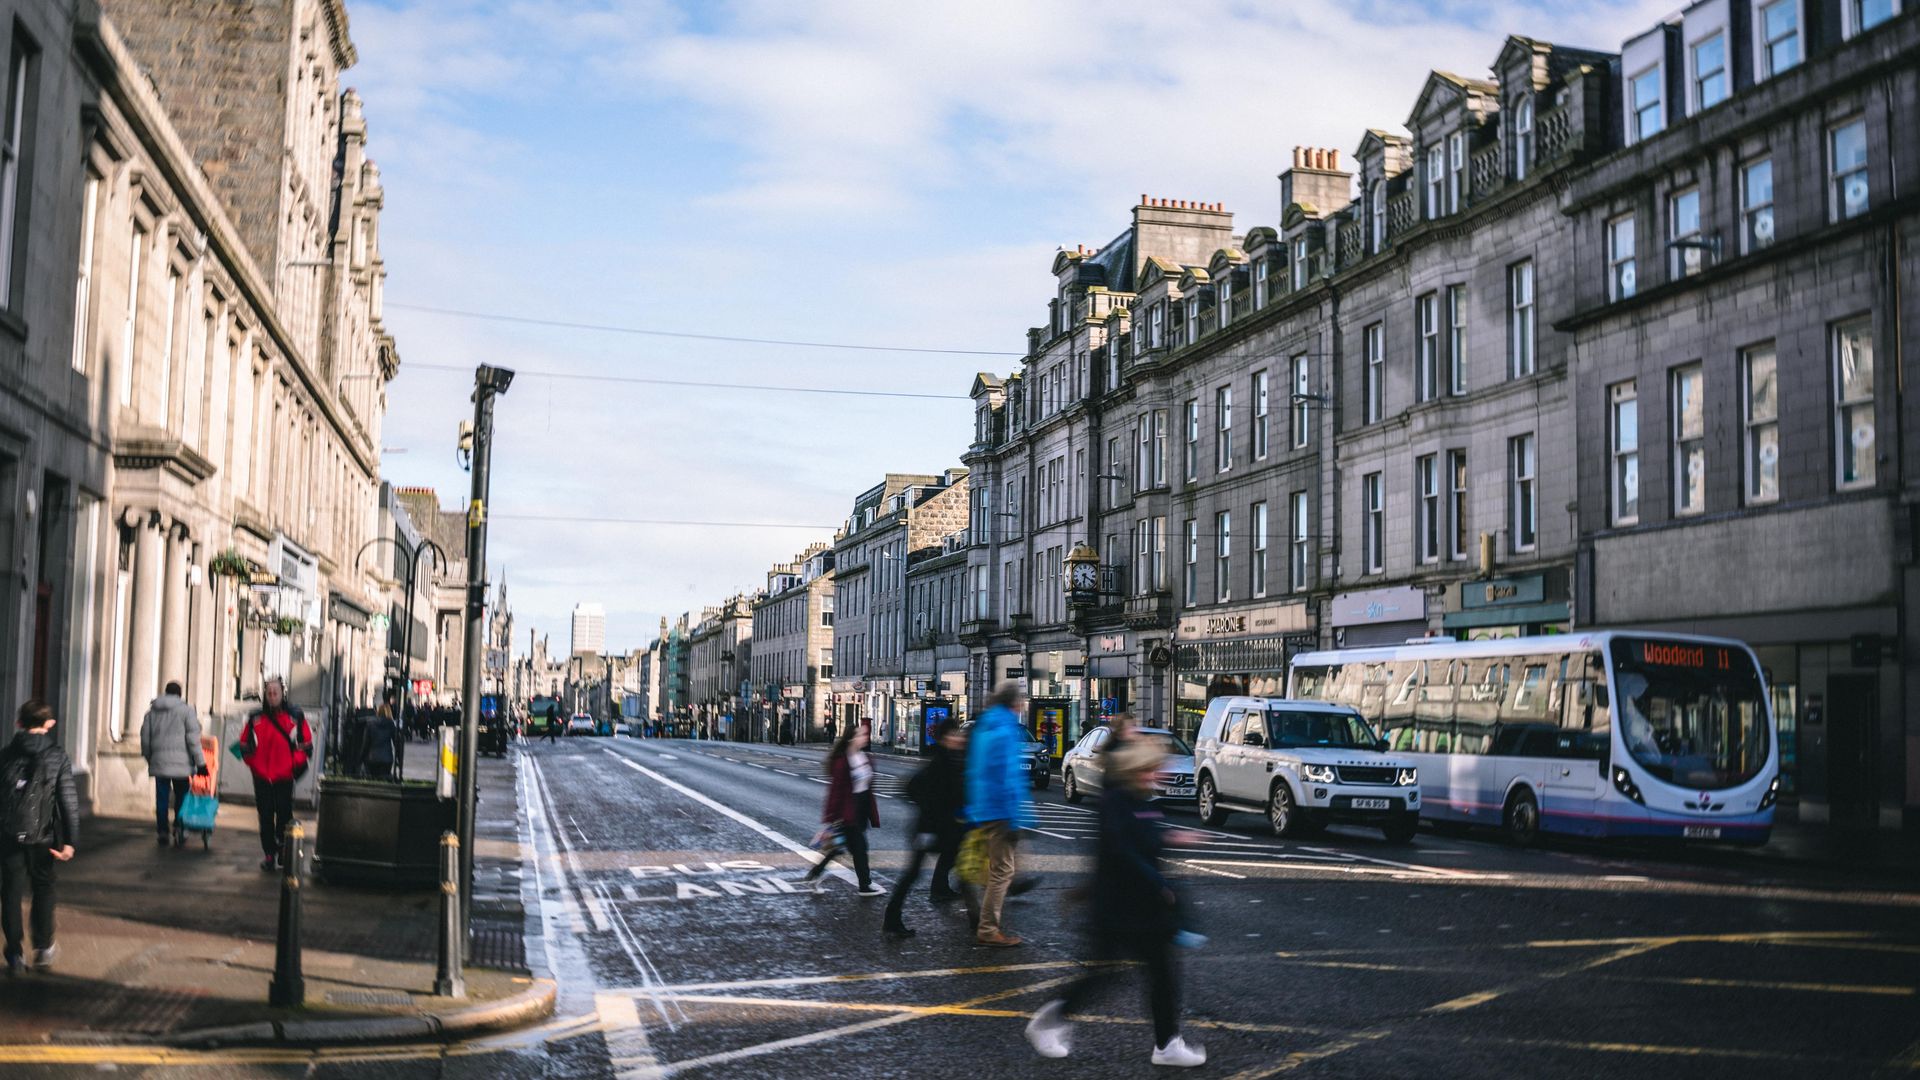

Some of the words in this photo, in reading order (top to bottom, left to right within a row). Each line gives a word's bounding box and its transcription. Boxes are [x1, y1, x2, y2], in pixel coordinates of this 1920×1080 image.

[1206, 616, 1240, 633] AMARONE
[1643, 641, 1704, 667] Woodend
[1717, 647, 1730, 670] 11
[628, 860, 776, 879] BUS
[619, 877, 830, 902] LANE
